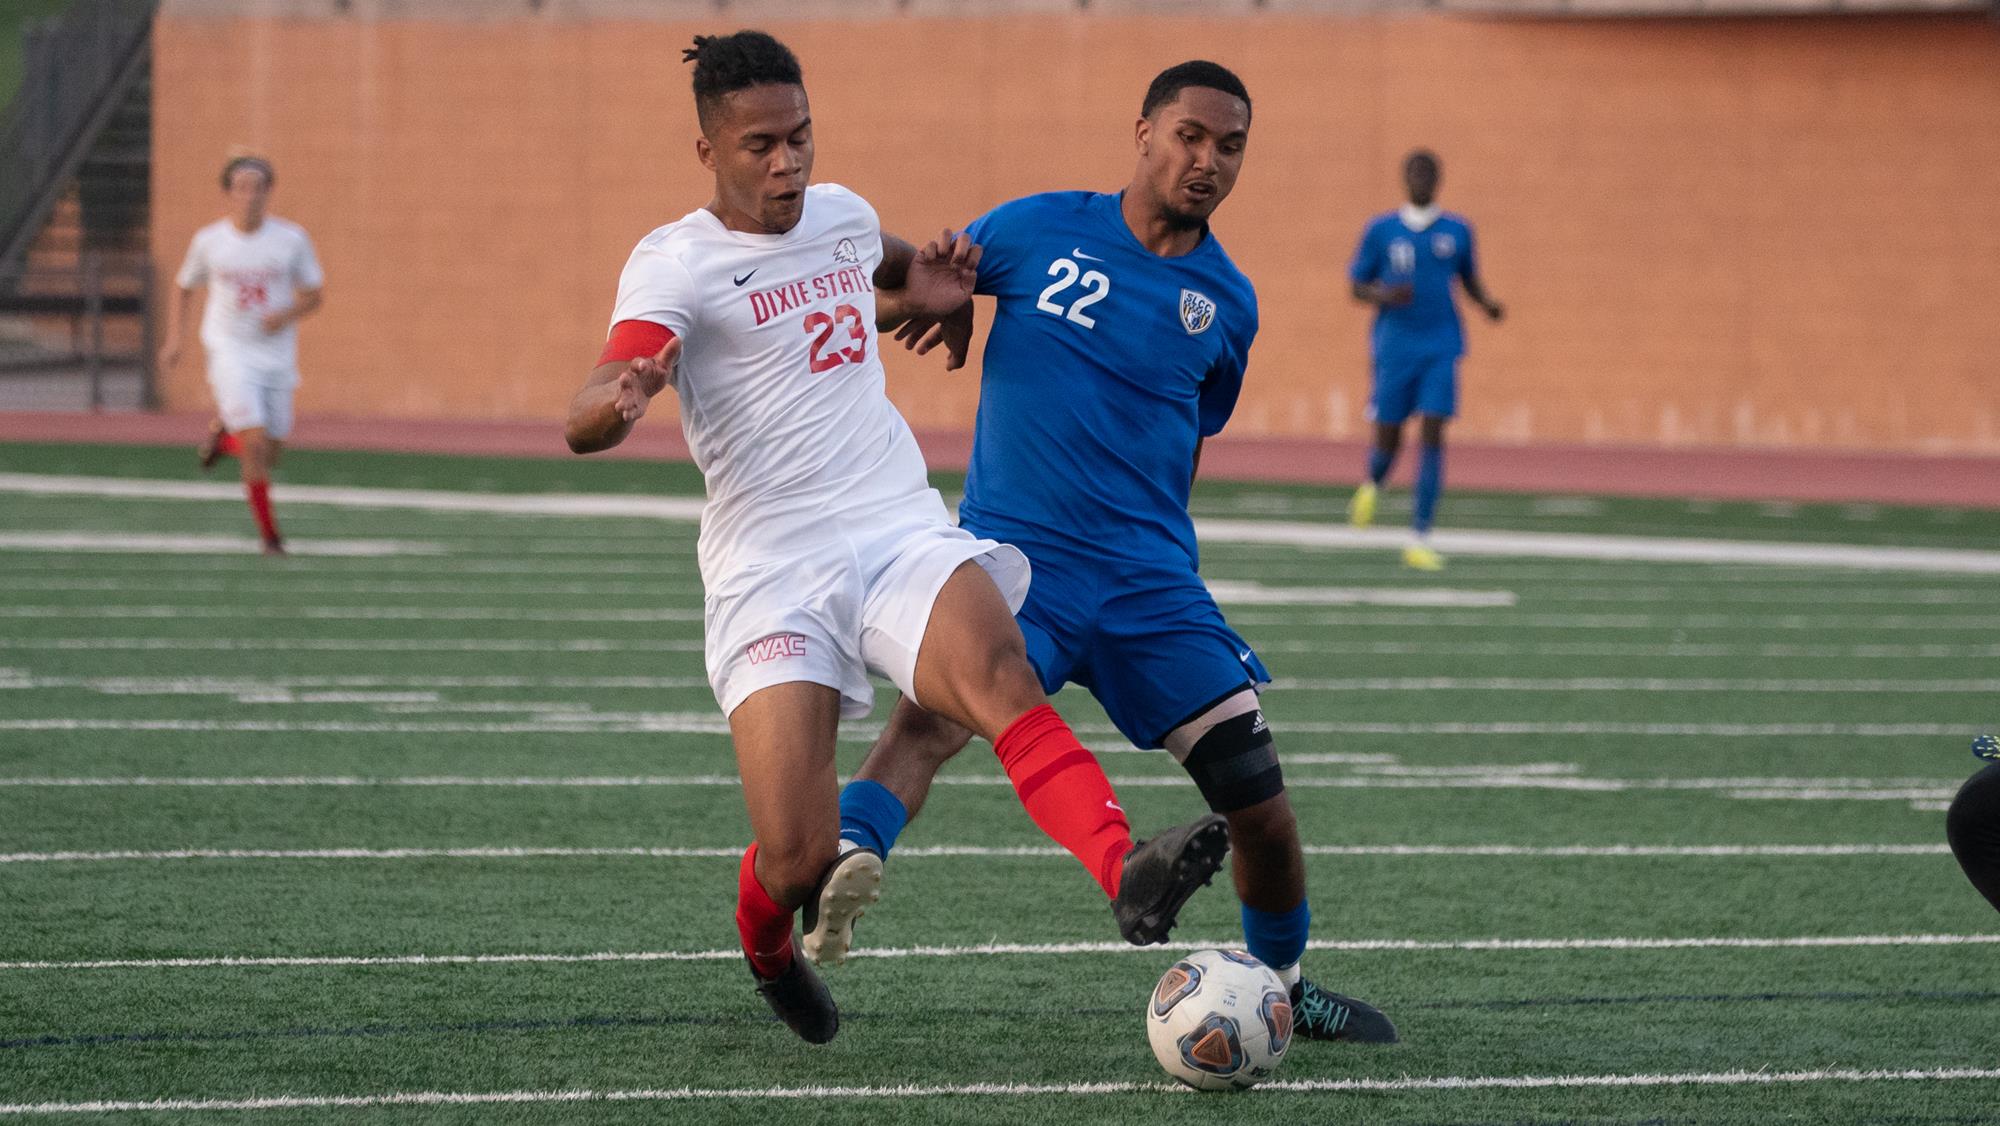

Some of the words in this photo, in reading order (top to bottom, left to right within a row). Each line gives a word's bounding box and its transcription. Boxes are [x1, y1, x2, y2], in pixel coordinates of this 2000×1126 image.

[749, 281, 811, 326] DIXIE
[812, 264, 872, 300] STATE
[1036, 257, 1110, 330] 22
[1186, 293, 1212, 314] SLCC
[804, 303, 868, 374] 23
[746, 634, 806, 665] WAC
